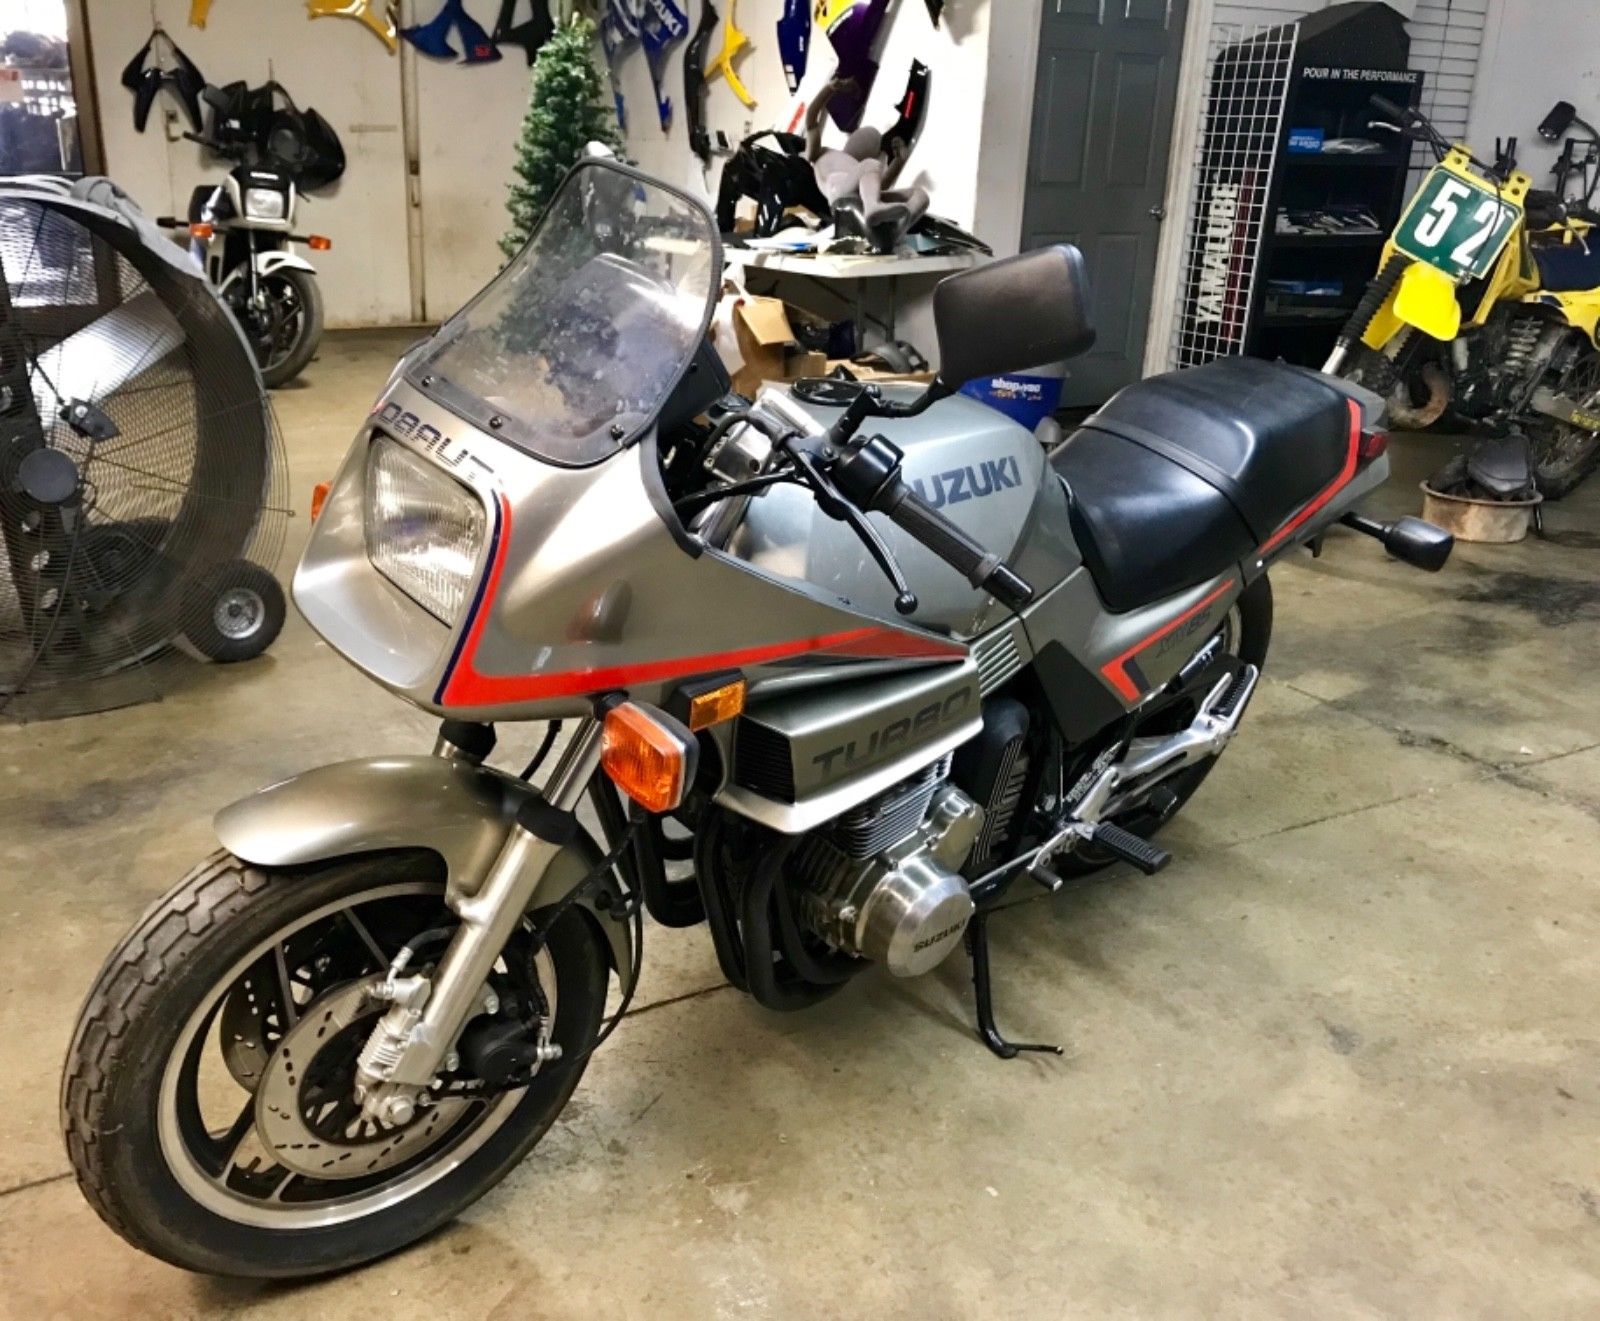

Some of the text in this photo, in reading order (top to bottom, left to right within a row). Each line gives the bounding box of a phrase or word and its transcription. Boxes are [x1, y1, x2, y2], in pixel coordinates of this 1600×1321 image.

[650, 0, 683, 36] ZUKI
[1303, 67, 1417, 83] POUR IN THE PERFORMANCE
[1197, 182, 1238, 322] YAMALUBE
[913, 455, 1023, 510] UZUKI
[812, 686, 972, 774] TURBO
[913, 917, 967, 952] SUZUKI
